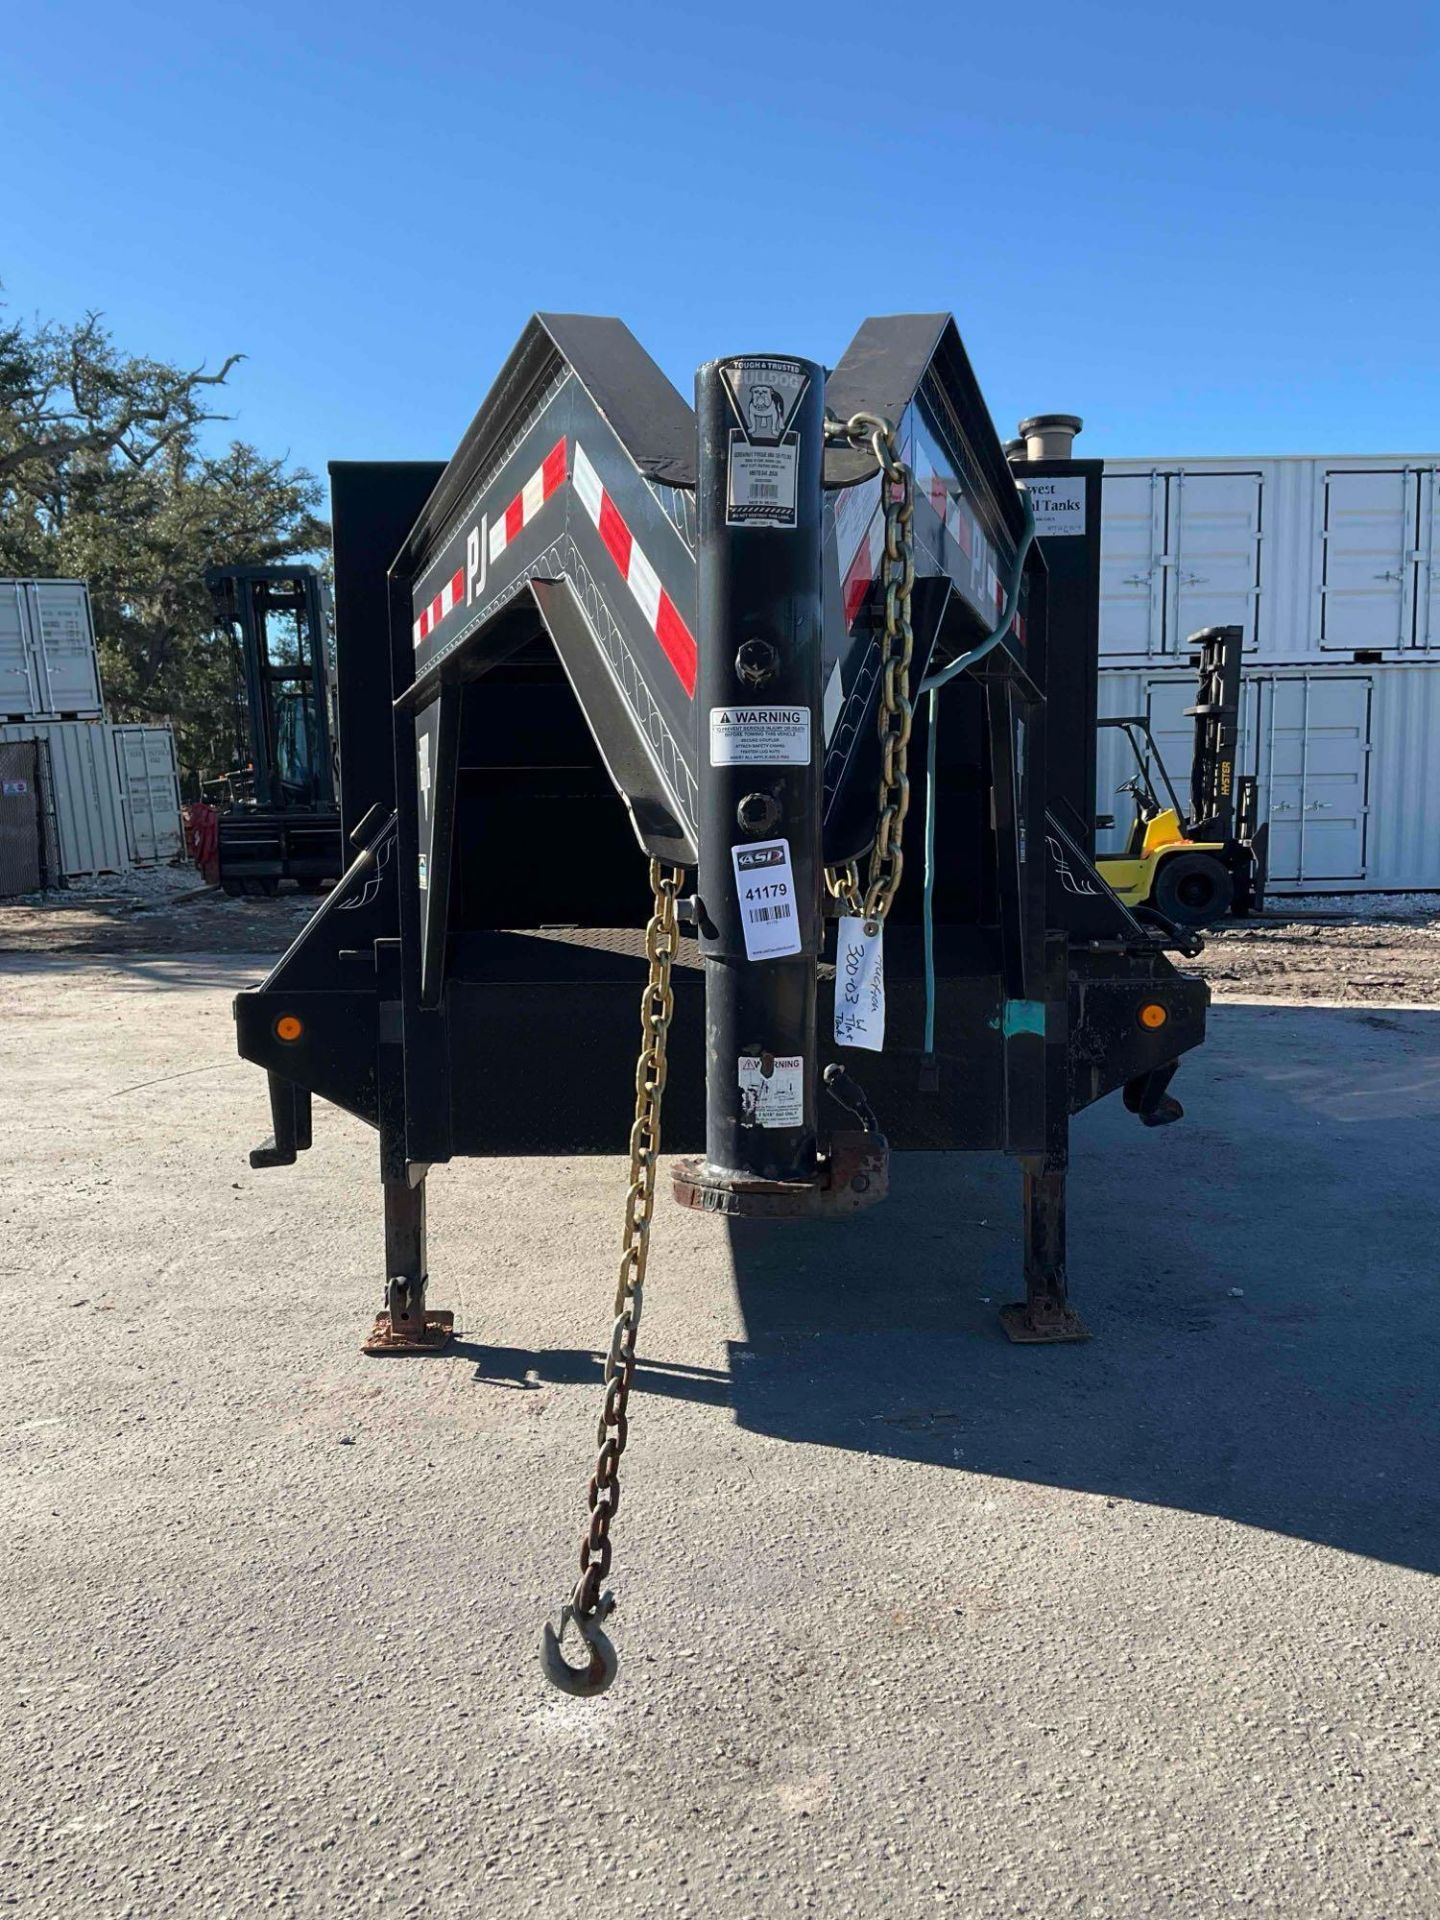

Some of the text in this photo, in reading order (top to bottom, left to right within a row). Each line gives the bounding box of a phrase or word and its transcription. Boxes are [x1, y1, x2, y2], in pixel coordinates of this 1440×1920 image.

[733, 361, 760, 369] TOUGH
[768, 362, 800, 373] TRUSTED
[733, 369, 799, 388] BULLDOG
[1026, 485, 1055, 495] west
[1042, 499, 1081, 511] Tanks
[466, 511, 488, 608] PJ
[735, 711, 801, 723] WARNING
[1221, 761, 1231, 796] HYSTER
[745, 883, 788, 901] 41179
[844, 944, 865, 1005] 300-03
[754, 1059, 800, 1069] WRNING
